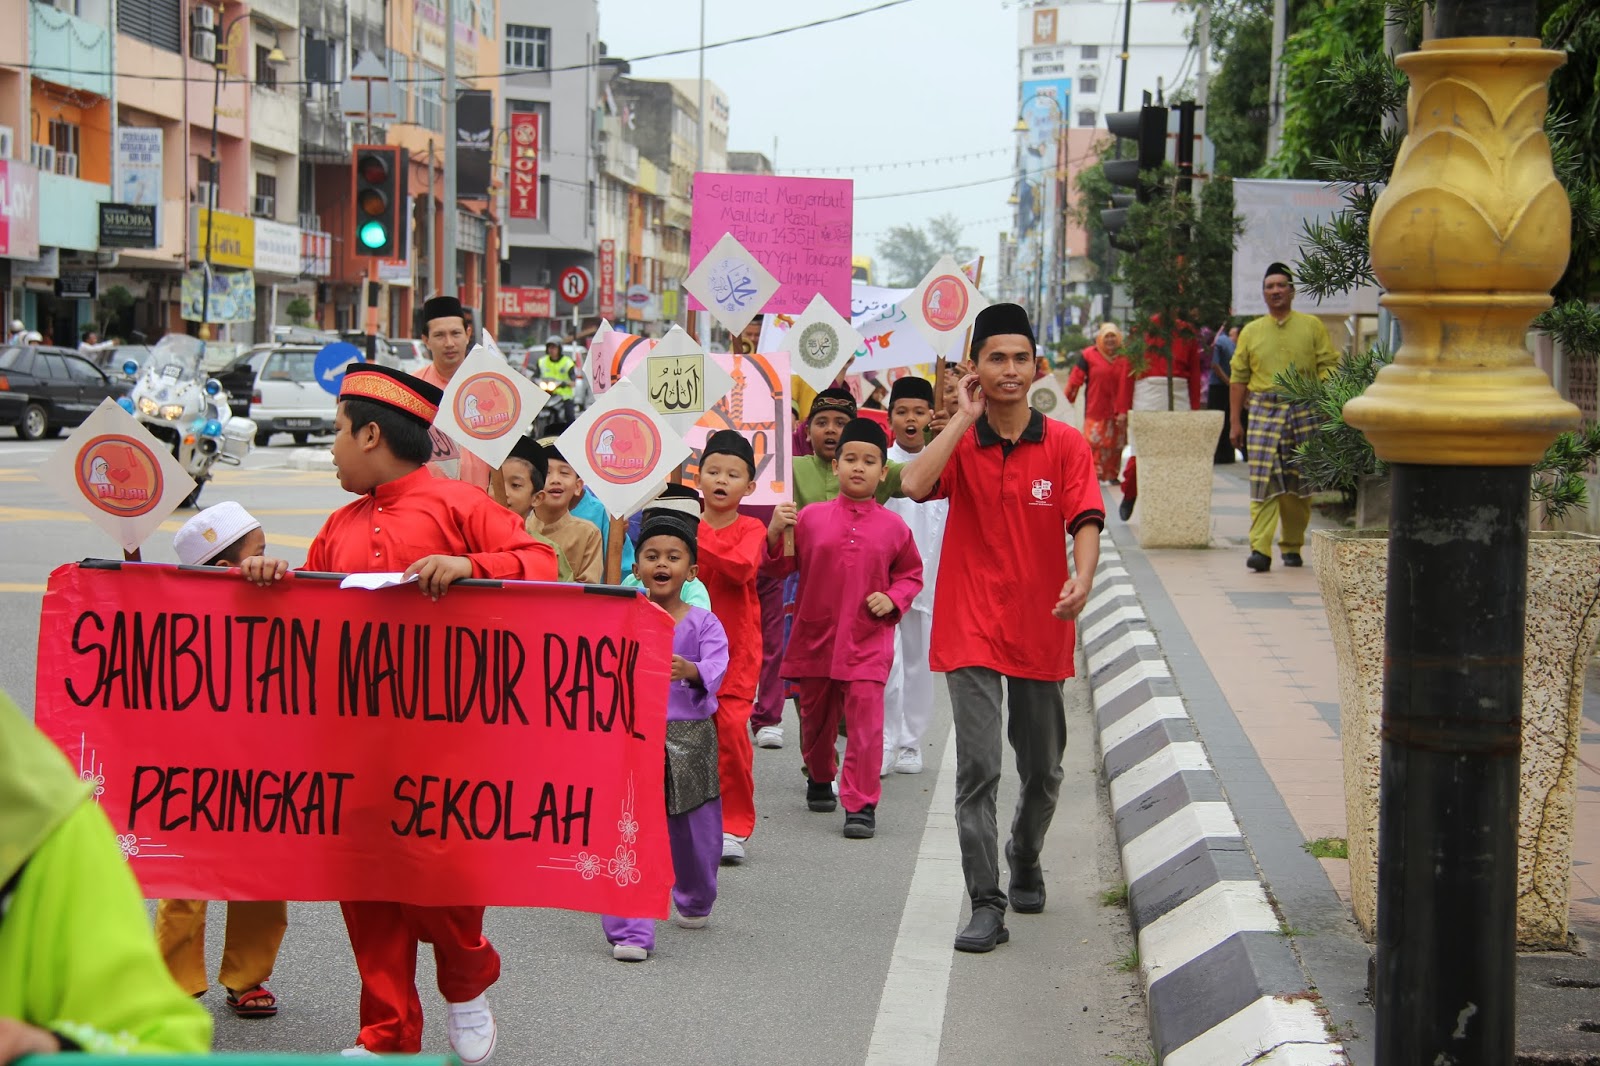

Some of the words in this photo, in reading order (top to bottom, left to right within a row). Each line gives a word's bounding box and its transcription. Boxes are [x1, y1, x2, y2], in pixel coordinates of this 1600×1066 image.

[706, 184, 770, 205] Selamat
[776, 186, 846, 211] Menyambut
[720, 206, 779, 224] Maulidur
[783, 208, 819, 227] Rasul
[730, 224, 769, 244] Tahun
[771, 227, 816, 247] 1435H
[65, 610, 318, 716] SAMBUTAN
[338, 620, 529, 727] MAULIDUR
[544, 633, 647, 741] RASUL
[127, 765, 355, 836] PERINGKAT
[391, 776, 595, 847] SEKOLAH
